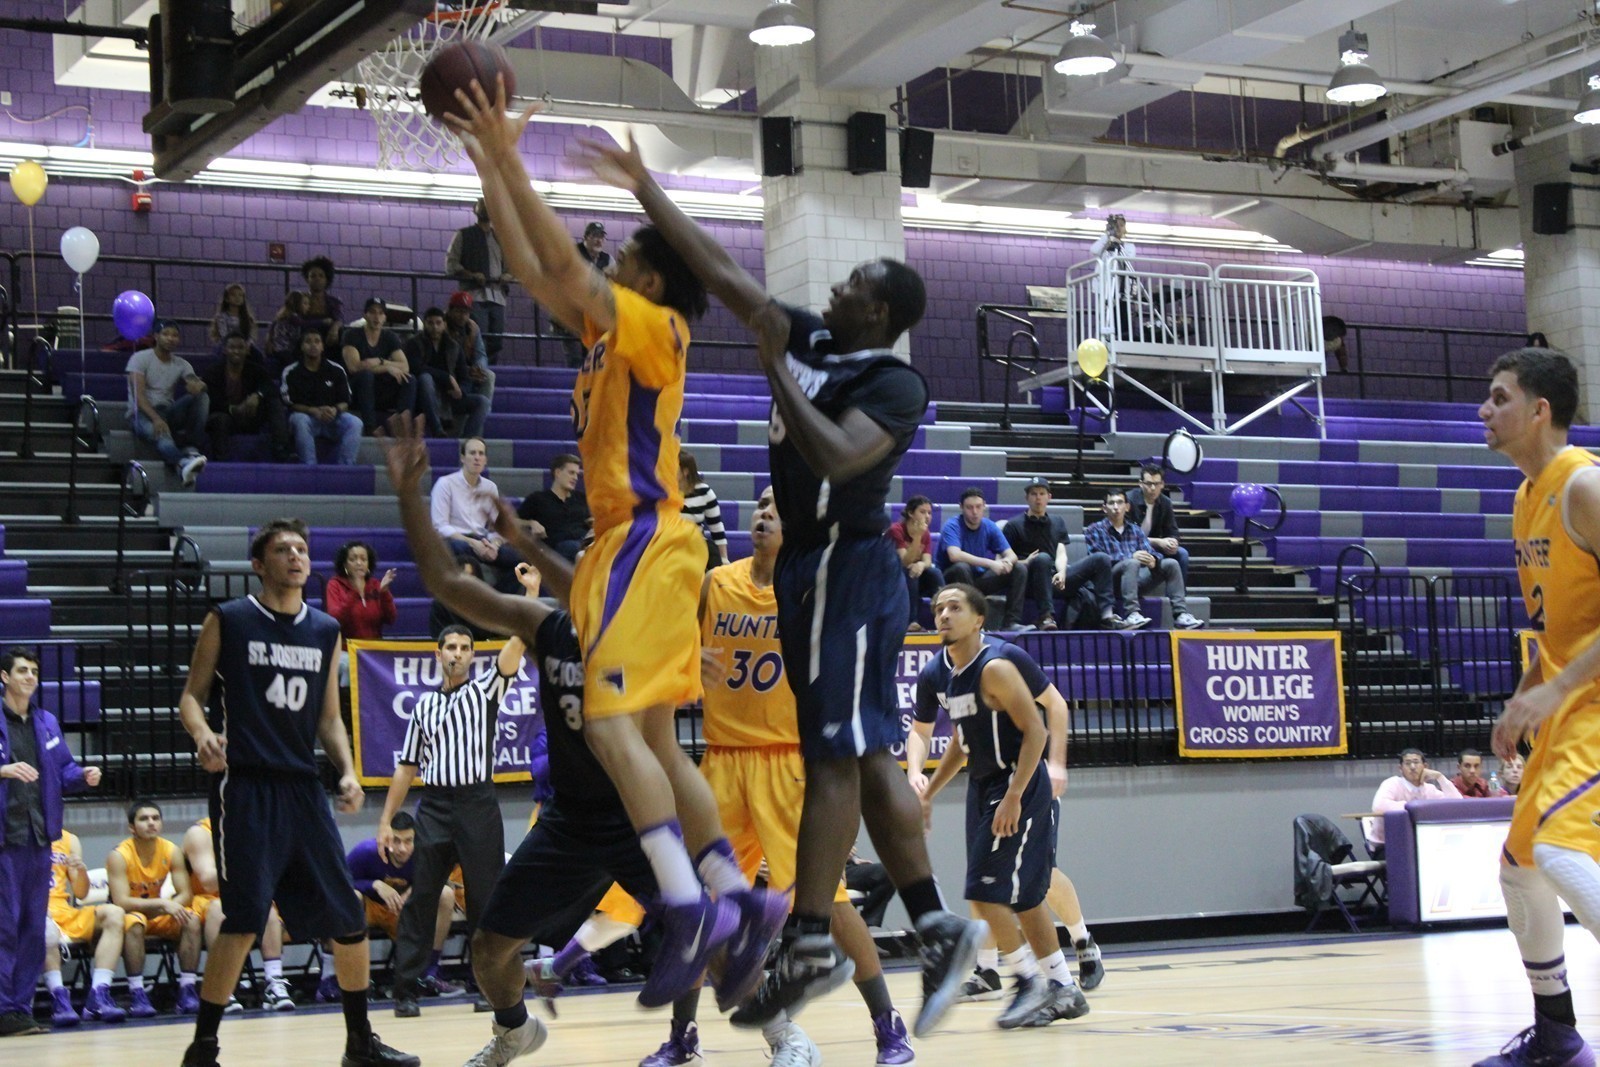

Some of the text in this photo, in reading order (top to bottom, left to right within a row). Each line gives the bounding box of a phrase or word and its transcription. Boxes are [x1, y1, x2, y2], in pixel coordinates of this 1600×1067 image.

[714, 612, 780, 639] HUNT
[393, 655, 532, 687] HUTR
[1205, 644, 1311, 671] HUNTER
[726, 649, 784, 694] 30
[265, 672, 308, 712] 40
[1206, 674, 1315, 701] COLLEGE
[1222, 704, 1300, 723] WOMEN'S
[1189, 725, 1333, 744] CROSS COUNTRY
